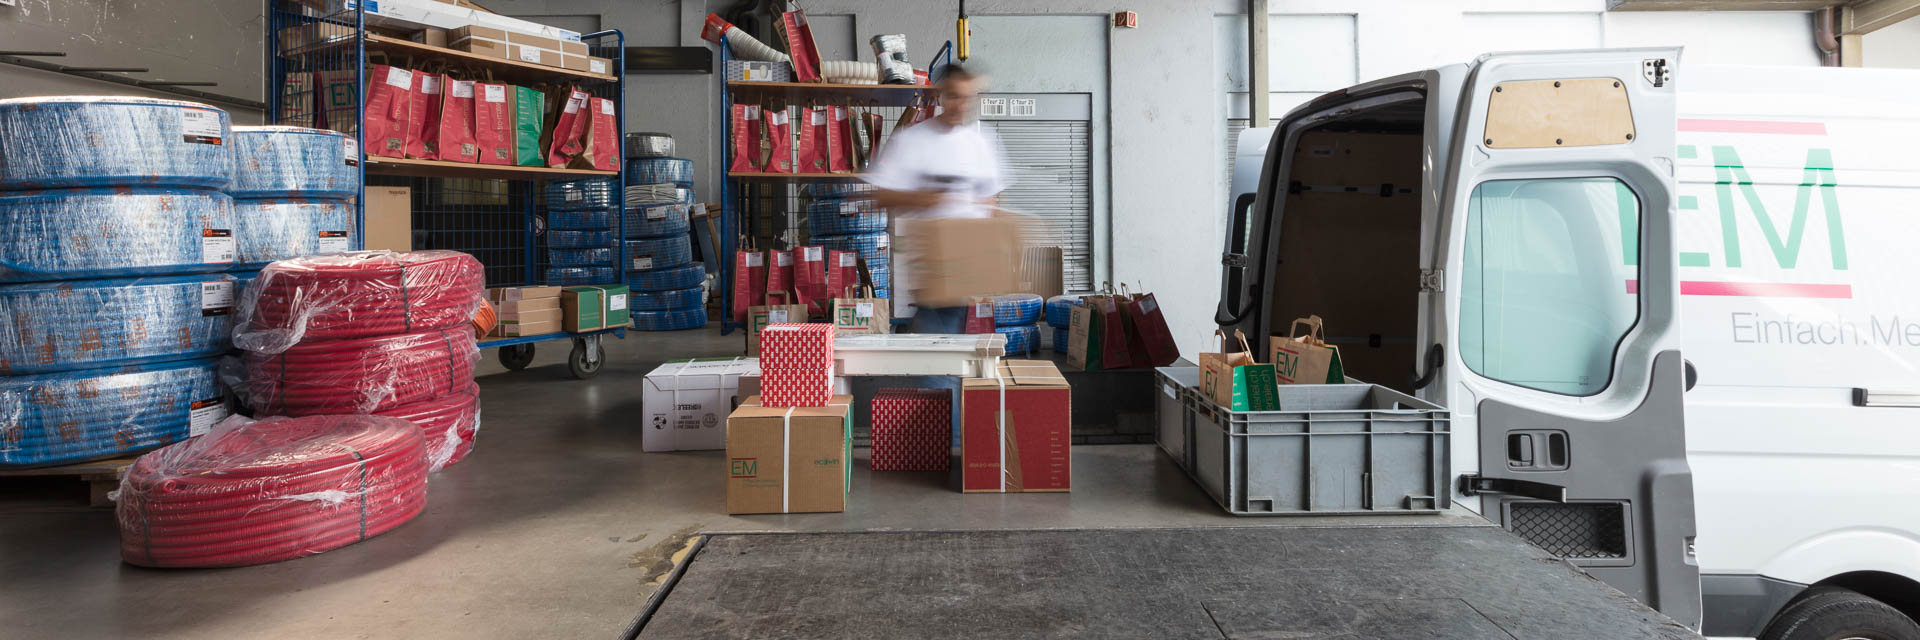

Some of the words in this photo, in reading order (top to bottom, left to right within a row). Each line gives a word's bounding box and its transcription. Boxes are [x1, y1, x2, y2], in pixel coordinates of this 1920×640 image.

[1615, 145, 1848, 270] EM
[1731, 311, 1920, 347] Einfach.Me
[1276, 351, 1299, 378] EM
[1205, 370, 1218, 400] EM
[731, 460, 757, 476] EM
